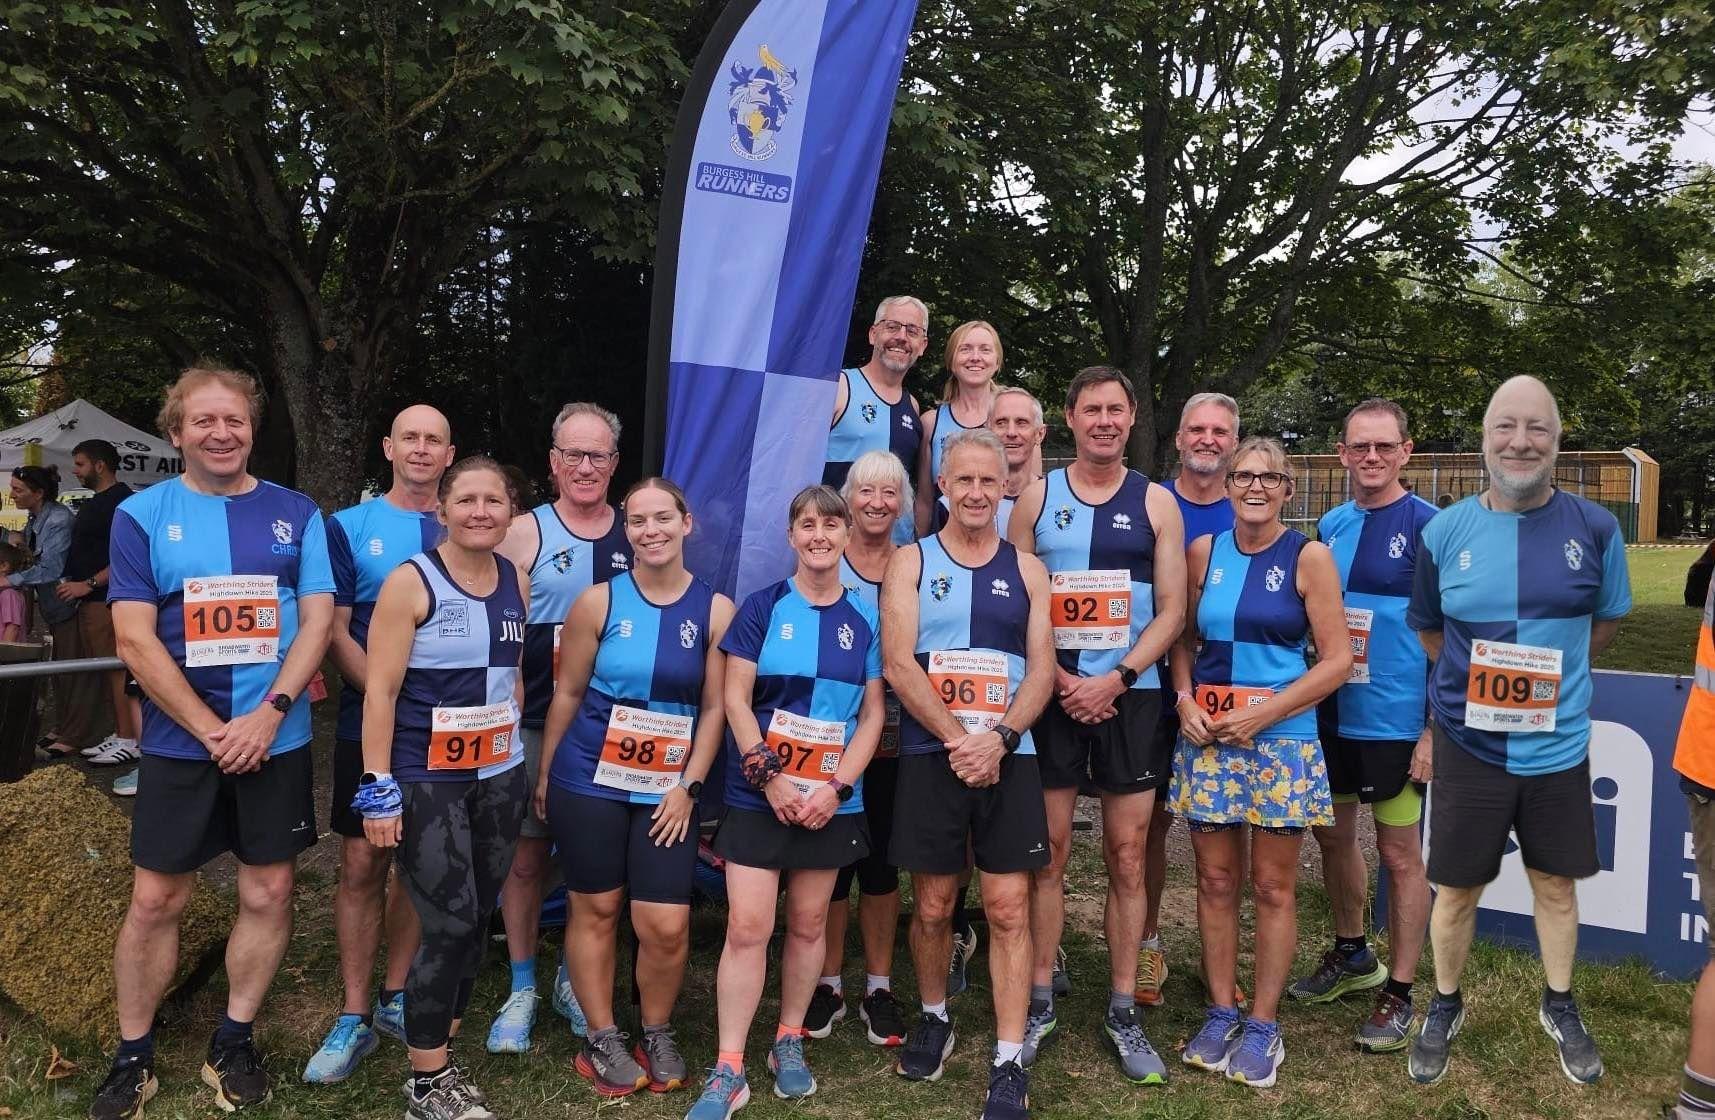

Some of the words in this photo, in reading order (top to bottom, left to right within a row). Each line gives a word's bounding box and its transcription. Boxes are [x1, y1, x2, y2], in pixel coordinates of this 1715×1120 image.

[697, 174, 789, 201] RUNNERS
[703, 165, 745, 180] BURGESS
[746, 172, 766, 184] HILL
[114, 454, 150, 472] RST
[192, 605, 255, 635] 105
[1063, 597, 1098, 622] 92
[442, 627, 466, 636] BHR
[941, 678, 976, 705] 96
[1475, 671, 1531, 704] 109
[455, 712, 489, 721] Worthing
[1205, 690, 1234, 716] 94
[446, 735, 482, 763] 91
[618, 736, 656, 765] 98
[777, 741, 815, 772] 97
